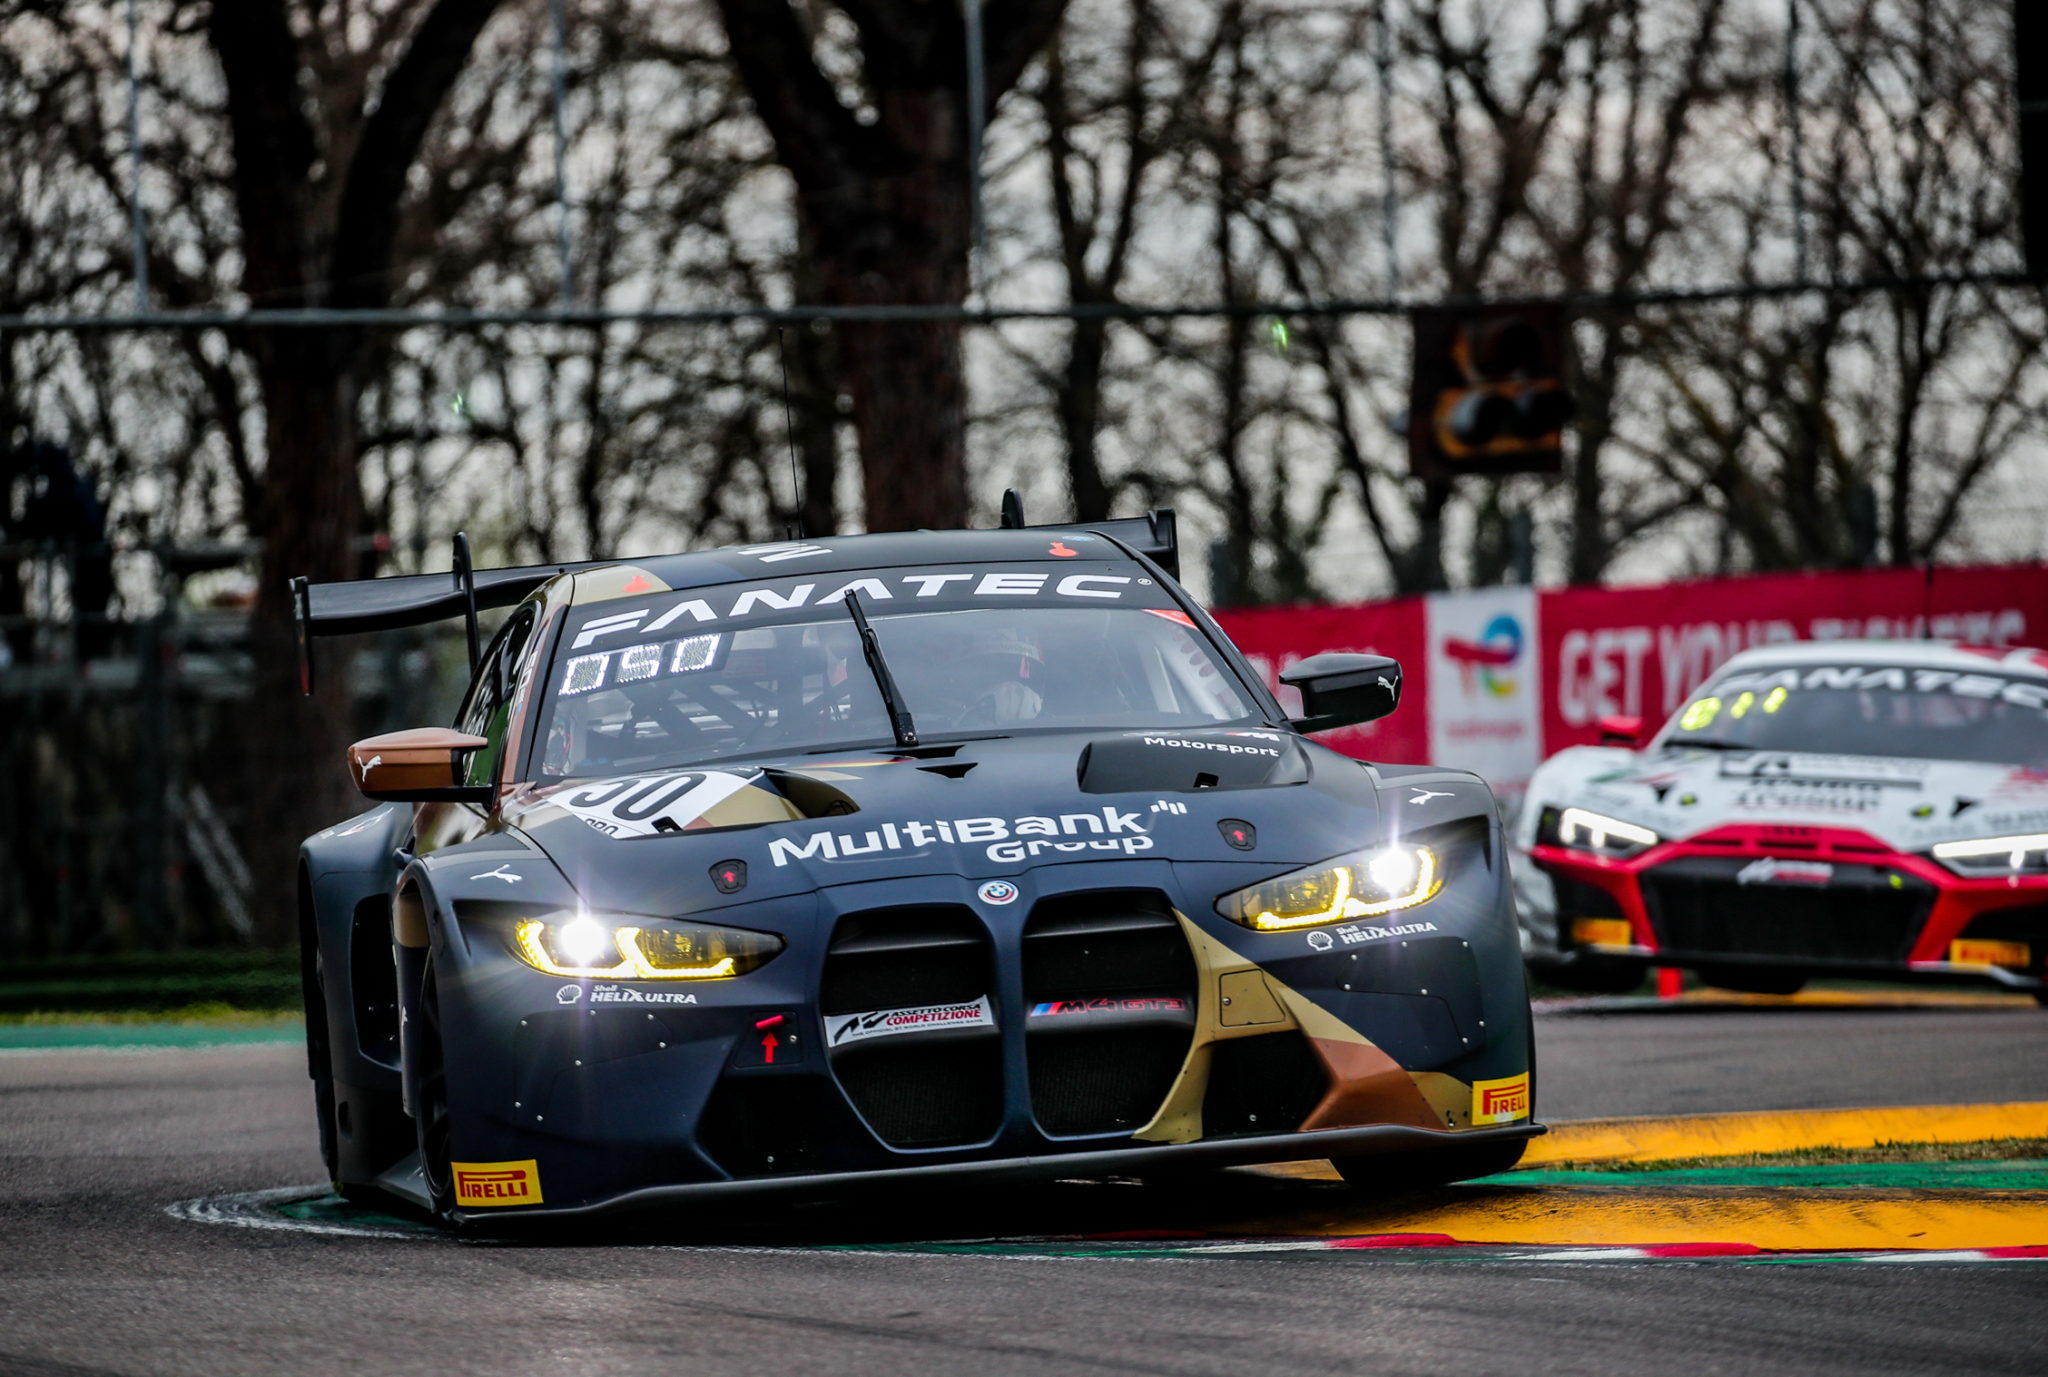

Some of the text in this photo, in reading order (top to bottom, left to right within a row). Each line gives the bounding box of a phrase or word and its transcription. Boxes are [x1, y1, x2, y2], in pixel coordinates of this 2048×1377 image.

[570, 573, 1132, 650] FANATEC
[557, 632, 722, 696] 050
[1558, 626, 1653, 728] GET
[1143, 737, 1279, 757] Motorsport
[768, 806, 1147, 867] MultiBank
[986, 836, 1154, 863] Group
[1336, 925, 1359, 935] Shell
[1340, 922, 1438, 945] HELIX ULTRA
[590, 988, 698, 1004] HELIX ULTRA
[886, 1009, 982, 1027] COMPETIZIONE
[890, 1003, 982, 1018] ASSETTO CORSA
[1482, 1082, 1526, 1116] PIRELL
[457, 1169, 529, 1198] PIRELLI
